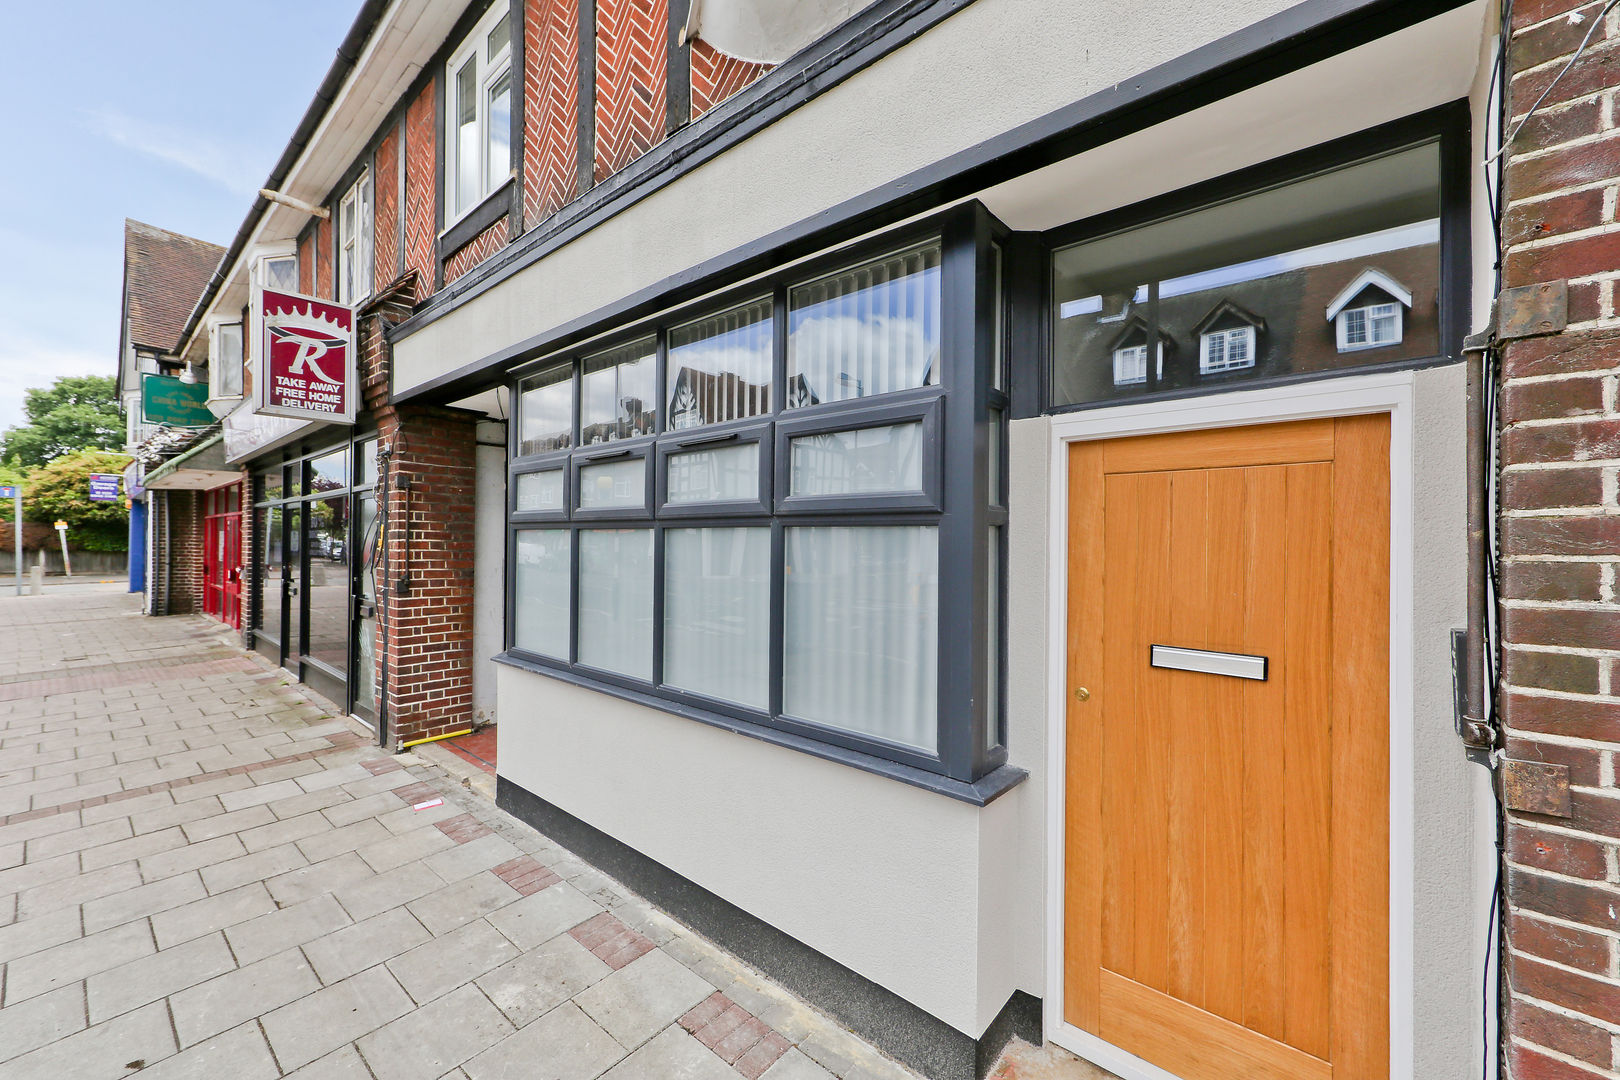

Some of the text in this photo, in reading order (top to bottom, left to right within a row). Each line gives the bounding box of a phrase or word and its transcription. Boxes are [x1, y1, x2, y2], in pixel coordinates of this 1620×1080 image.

[275, 376, 341, 393] TAKE AWAY
[275, 386, 342, 404] FREE HOME
[281, 397, 338, 413] DELIVERY
